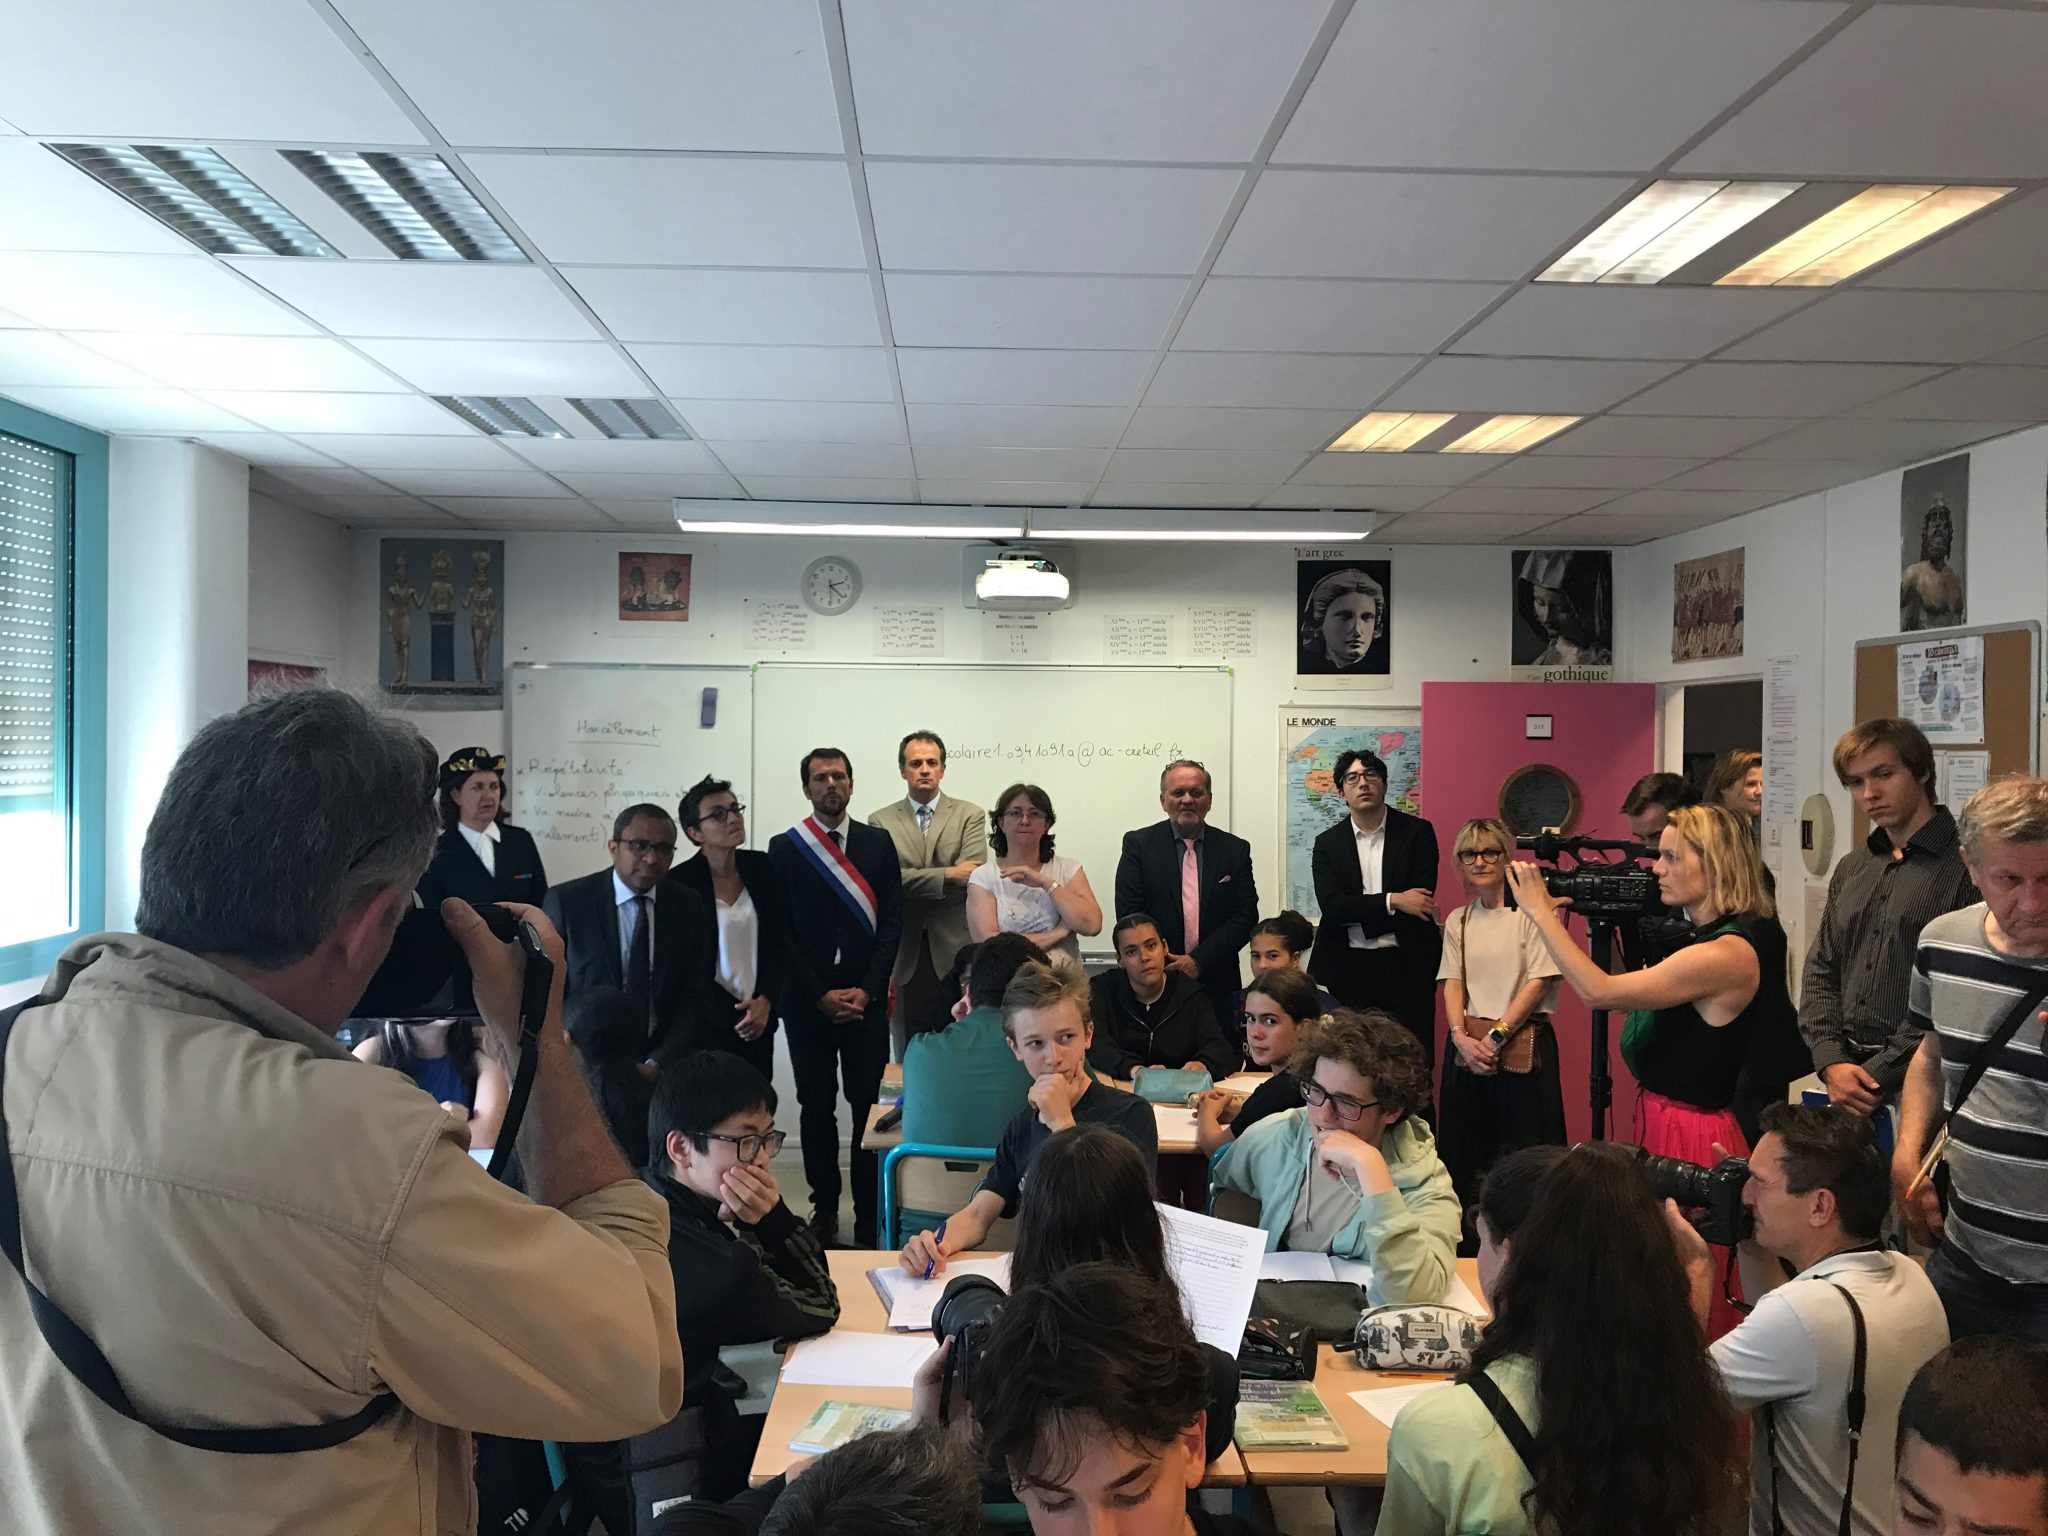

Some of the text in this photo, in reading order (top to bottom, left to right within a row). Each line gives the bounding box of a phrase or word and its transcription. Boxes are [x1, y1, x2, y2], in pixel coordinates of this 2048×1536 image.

[1297, 548, 1345, 560] L'art grec
[1543, 665, 1609, 683] gothique
[1286, 717, 1337, 726] LE MONDE
